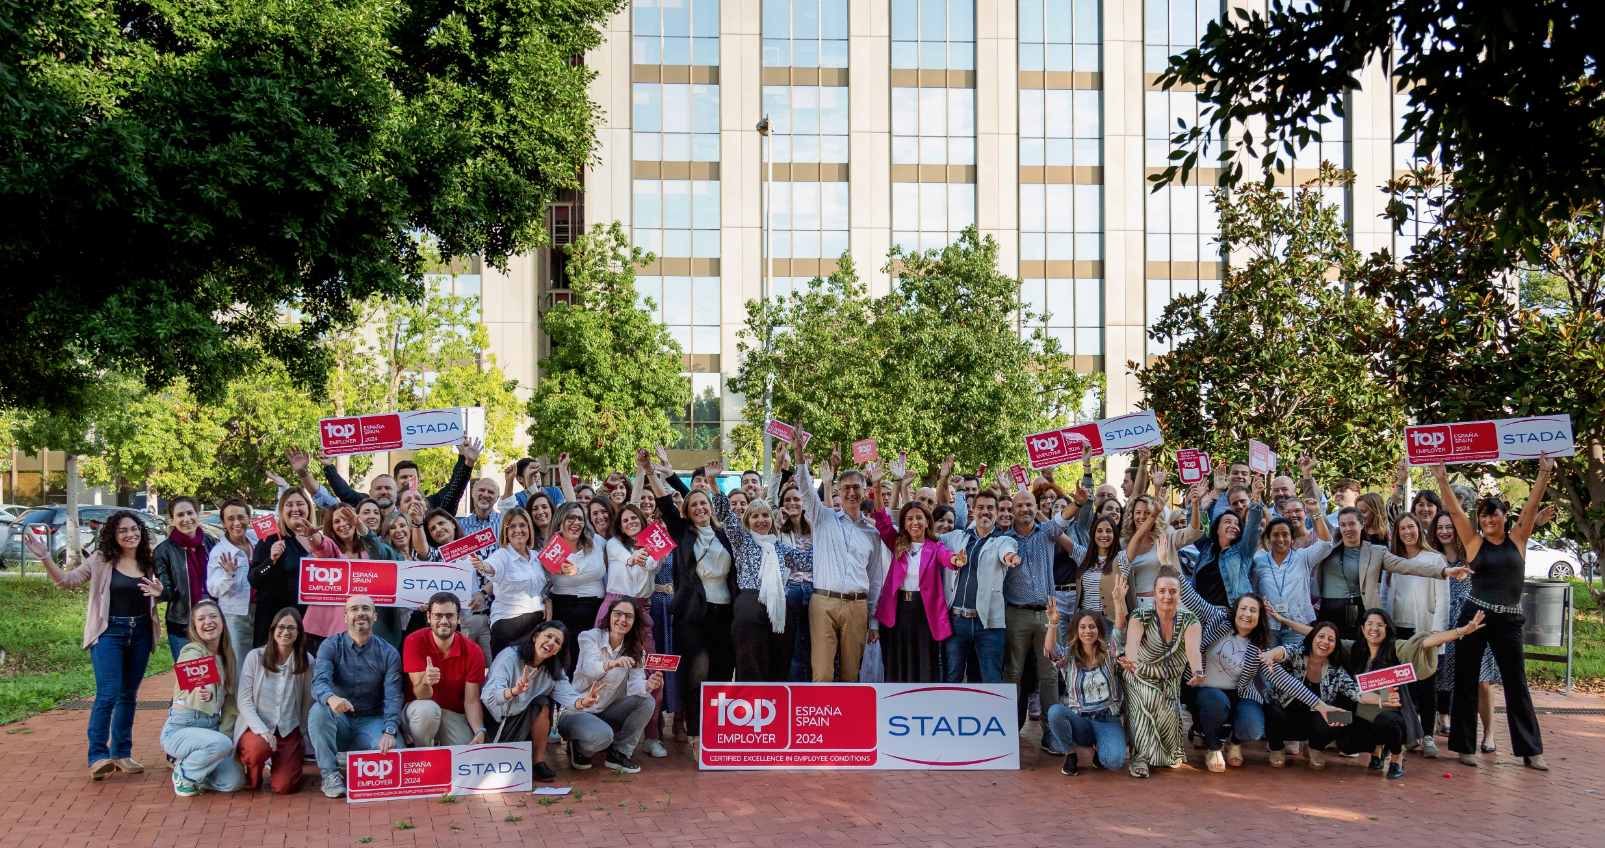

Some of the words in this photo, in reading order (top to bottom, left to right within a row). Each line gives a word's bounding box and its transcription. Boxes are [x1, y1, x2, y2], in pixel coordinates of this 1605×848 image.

[324, 423, 355, 439] top
[406, 422, 459, 435] STADA
[1105, 424, 1155, 440] STADA
[1030, 436, 1058, 452] top
[1410, 430, 1444, 448] top
[1503, 431, 1567, 444] STADA
[1036, 450, 1061, 459] EMPLOYER
[475, 532, 492, 543] top
[650, 530, 667, 548] top
[545, 543, 561, 561] top
[306, 564, 342, 585] top
[403, 579, 466, 591] STADA
[183, 664, 208, 677] top
[1393, 668, 1411, 678] top
[711, 692, 776, 732] top
[796, 704, 842, 716] ESPAÑA
[796, 717, 830, 727] SPAIN
[888, 716, 1006, 736] STADA
[717, 734, 776, 743] EMPLOYER
[796, 734, 823, 744] 2024
[353, 758, 393, 779] top
[458, 761, 526, 776] STADA
[358, 779, 392, 787] EMPLOYER
